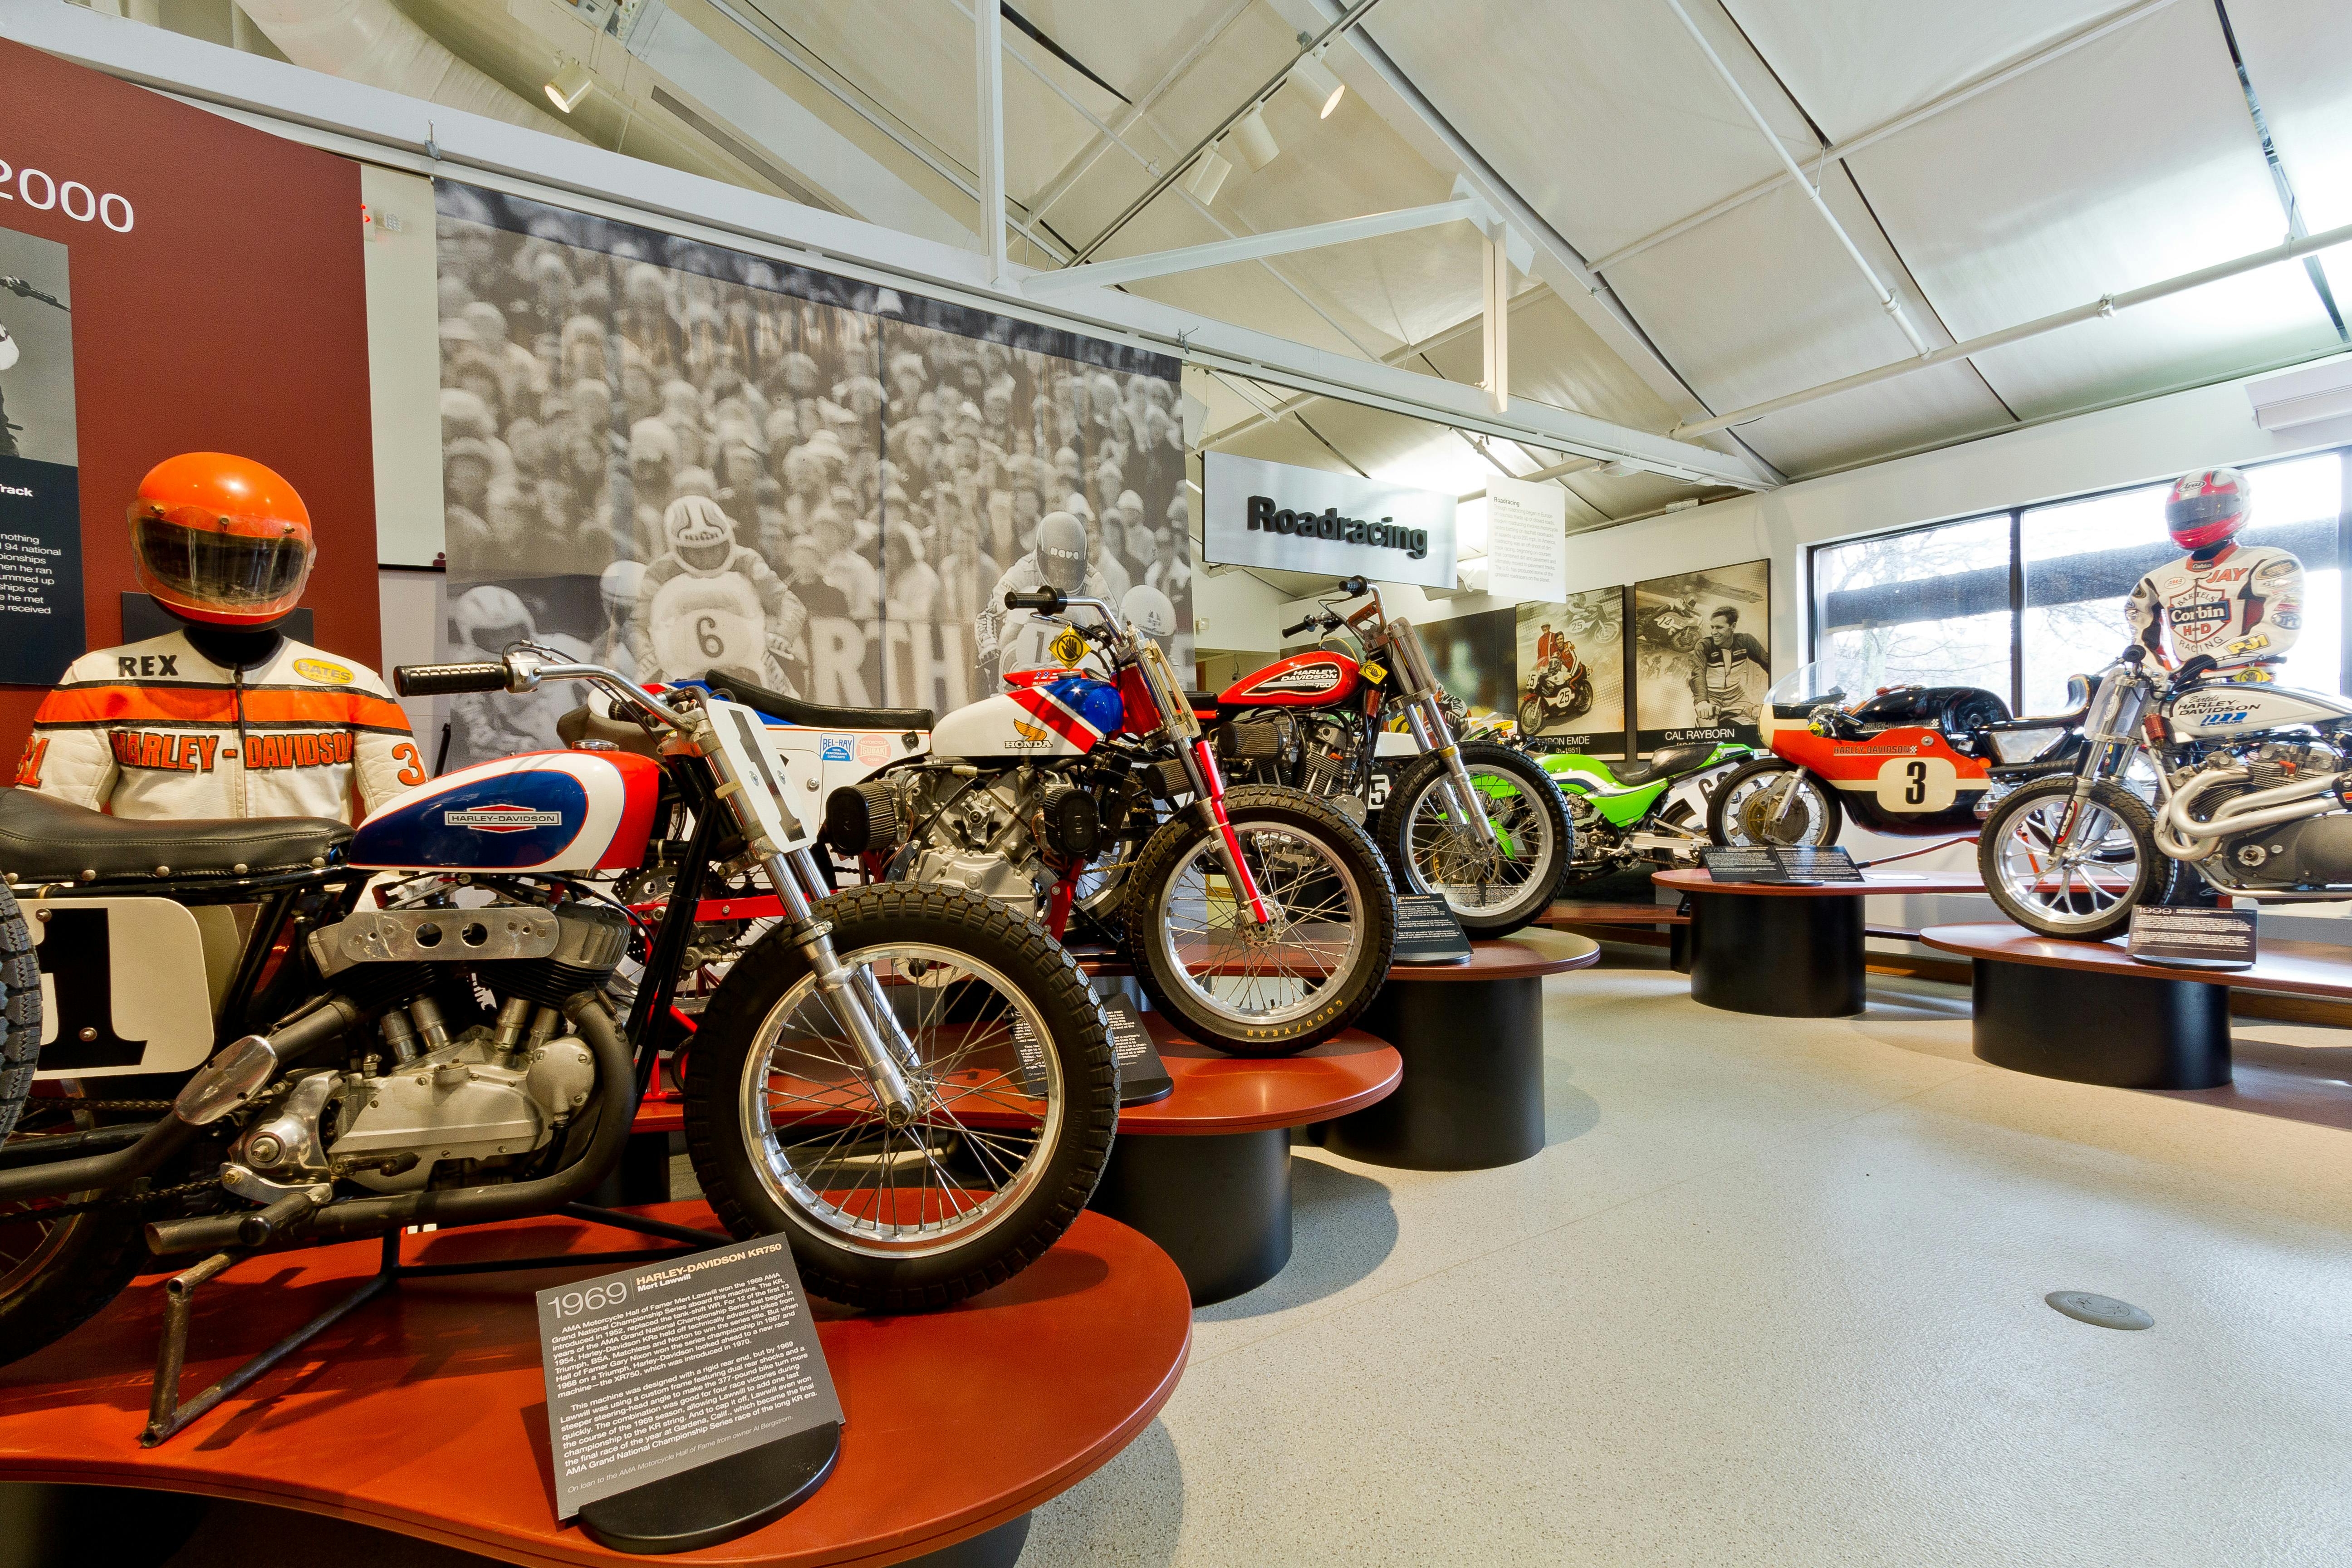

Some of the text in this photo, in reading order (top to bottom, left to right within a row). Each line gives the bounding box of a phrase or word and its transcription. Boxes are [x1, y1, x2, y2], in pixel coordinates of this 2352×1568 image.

[0, 484, 33, 496] rack
[1494, 496, 1520, 507] Roadracing
[1247, 495, 1428, 560] Roadracing
[0, 533, 39, 544] nothing
[21, 546, 61, 556] national
[2206, 568, 2249, 583] JAY
[8, 605, 51, 614] received
[2171, 606, 2225, 622] Corbin
[1571, 621, 1583, 632] 25
[1659, 616, 1672, 627] 14
[2183, 623, 2211, 636] H-D
[696, 617, 725, 658] 6
[2179, 636, 2223, 652] RACING
[118, 654, 179, 677] REX
[298, 662, 351, 681] BATES
[1526, 674, 1536, 687] 25
[1559, 690, 1570, 704] 25
[2177, 699, 2240, 710] HARLEY-
[2178, 704, 2262, 715] DAVIDSON
[1567, 736, 1590, 745] EMDE
[1665, 729, 1735, 740] CAL RAYBORN
[823, 738, 853, 752] BEL-RAY
[1004, 740, 1053, 749] HONDA
[1833, 745, 1911, 754] HARLEY-DAVIDSON
[392, 742, 426, 787] 3
[727, 709, 807, 843] 1
[1905, 761, 1926, 805] 3
[451, 814, 555, 824] HARLEY-DAVIDSON
[35, 907, 148, 1072] 1
[1246, 999, 1343, 1038] GOODYEAR
[636, 1243, 781, 1285] HARLEY-DAVIDSON KR750
[637, 1273, 691, 1292] Mert Lawwill
[548, 1282, 627, 1318] 1969
[562, 1324, 581, 1334] AMA
[582, 1313, 624, 1328] Motorcycle
[625, 1308, 640, 1317] Hall
[650, 1301, 673, 1311] Famer
[674, 1295, 691, 1304] Mert
[691, 1289, 717, 1300] Lawwill
[746, 1277, 763, 1285] 1969
[764, 1272, 781, 1281] AMA
[551, 1332, 576, 1343] Grand
[578, 1323, 609, 1337] National
[610, 1311, 663, 1328] Championship
[664, 1304, 687, 1314] Series
[688, 1297, 713, 1308] aboard
[727, 1286, 758, 1298] machine.
[553, 1349, 575, 1360] years
[600, 1337, 619, 1346] AMA
[621, 1330, 644, 1341] Grand
[645, 1321, 675, 1334] National
[676, 1308, 727, 1325] Championship
[728, 1302, 750, 1312] Series
[750, 1298, 764, 1306] that
[764, 1292, 786, 1302] began
[553, 1335, 594, 1351] introduced
[605, 1328, 625, 1337] 1952,
[627, 1318, 659, 1331] replaced
[673, 1306, 706, 1319] tank-shift
[707, 1302, 722, 1310] WR.
